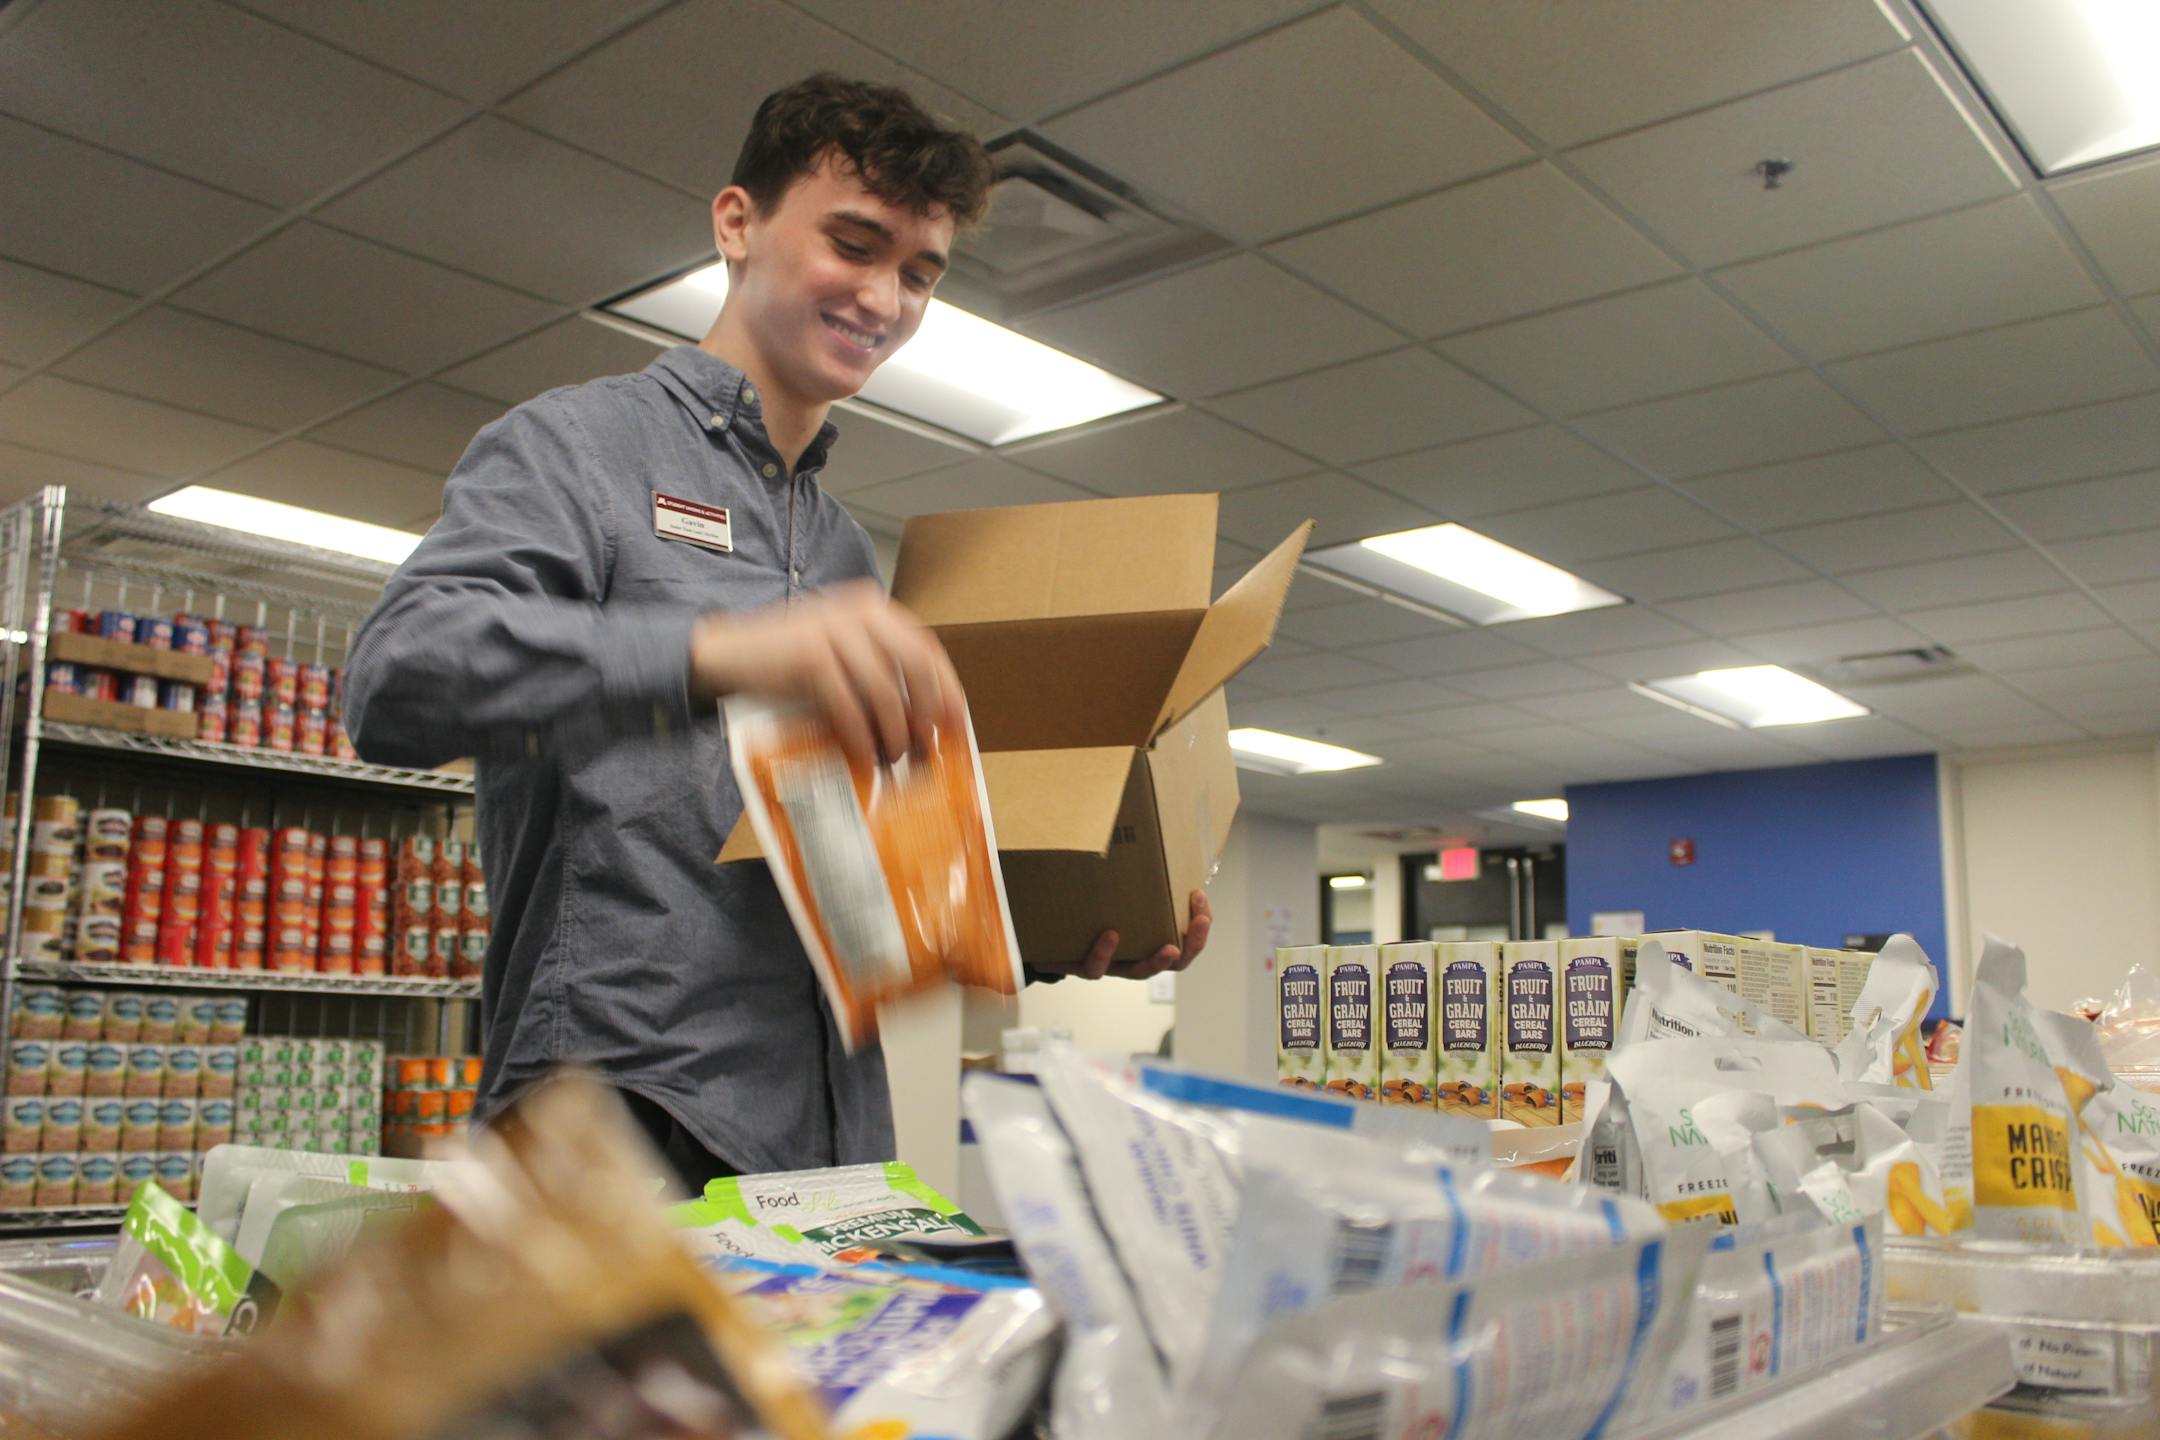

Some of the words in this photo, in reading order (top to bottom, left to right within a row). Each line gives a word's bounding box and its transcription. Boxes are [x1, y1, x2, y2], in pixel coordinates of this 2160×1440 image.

[1395, 963, 1419, 971] PAMPA
[1452, 962, 1477, 970] PAMPA
[1518, 962, 1543, 970] PAMPA
[1575, 958, 1602, 966] PAMPA
[1289, 965, 1311, 974] PAMPA
[1339, 965, 1362, 973] PAMPA
[1284, 981, 1316, 997] FRUIT
[1334, 981, 1367, 997] FRUIT
[1389, 979, 1424, 995] FRUIT
[1447, 979, 1483, 995] FRUIT
[1512, 979, 1549, 995] FRUIT
[1569, 975, 1608, 993] FRUIT
[1284, 1003, 1317, 1019] GRAIN
[1334, 1004, 1368, 1019] GRAIN
[1389, 1003, 1425, 1018] GRAIN
[1446, 1003, 1484, 1019] GRAIN
[1511, 1003, 1550, 1020] GRAIN
[1569, 1000, 1610, 1017] GRAIN
[1286, 1019, 1315, 1028] CEREAL
[1336, 1020, 1365, 1029] CEREAL
[1392, 1019, 1422, 1028] CEREAL
[1449, 1020, 1481, 1029] CEREAL
[1514, 1020, 1547, 1030] CEREAL
[1572, 1017, 1607, 1028] CEREAL
[1651, 1007, 1694, 1037] Nutrition
[1292, 1028, 1311, 1037] BARS
[1342, 1029, 1361, 1037] BARS
[1398, 1028, 1419, 1037] BARS
[1455, 1029, 1477, 1038] BARS
[1520, 1030, 1543, 1039] BARS
[1579, 1027, 1602, 1037] BARS
[756, 1192, 800, 1209] Food
[824, 1209, 916, 1235] PREMIUM
